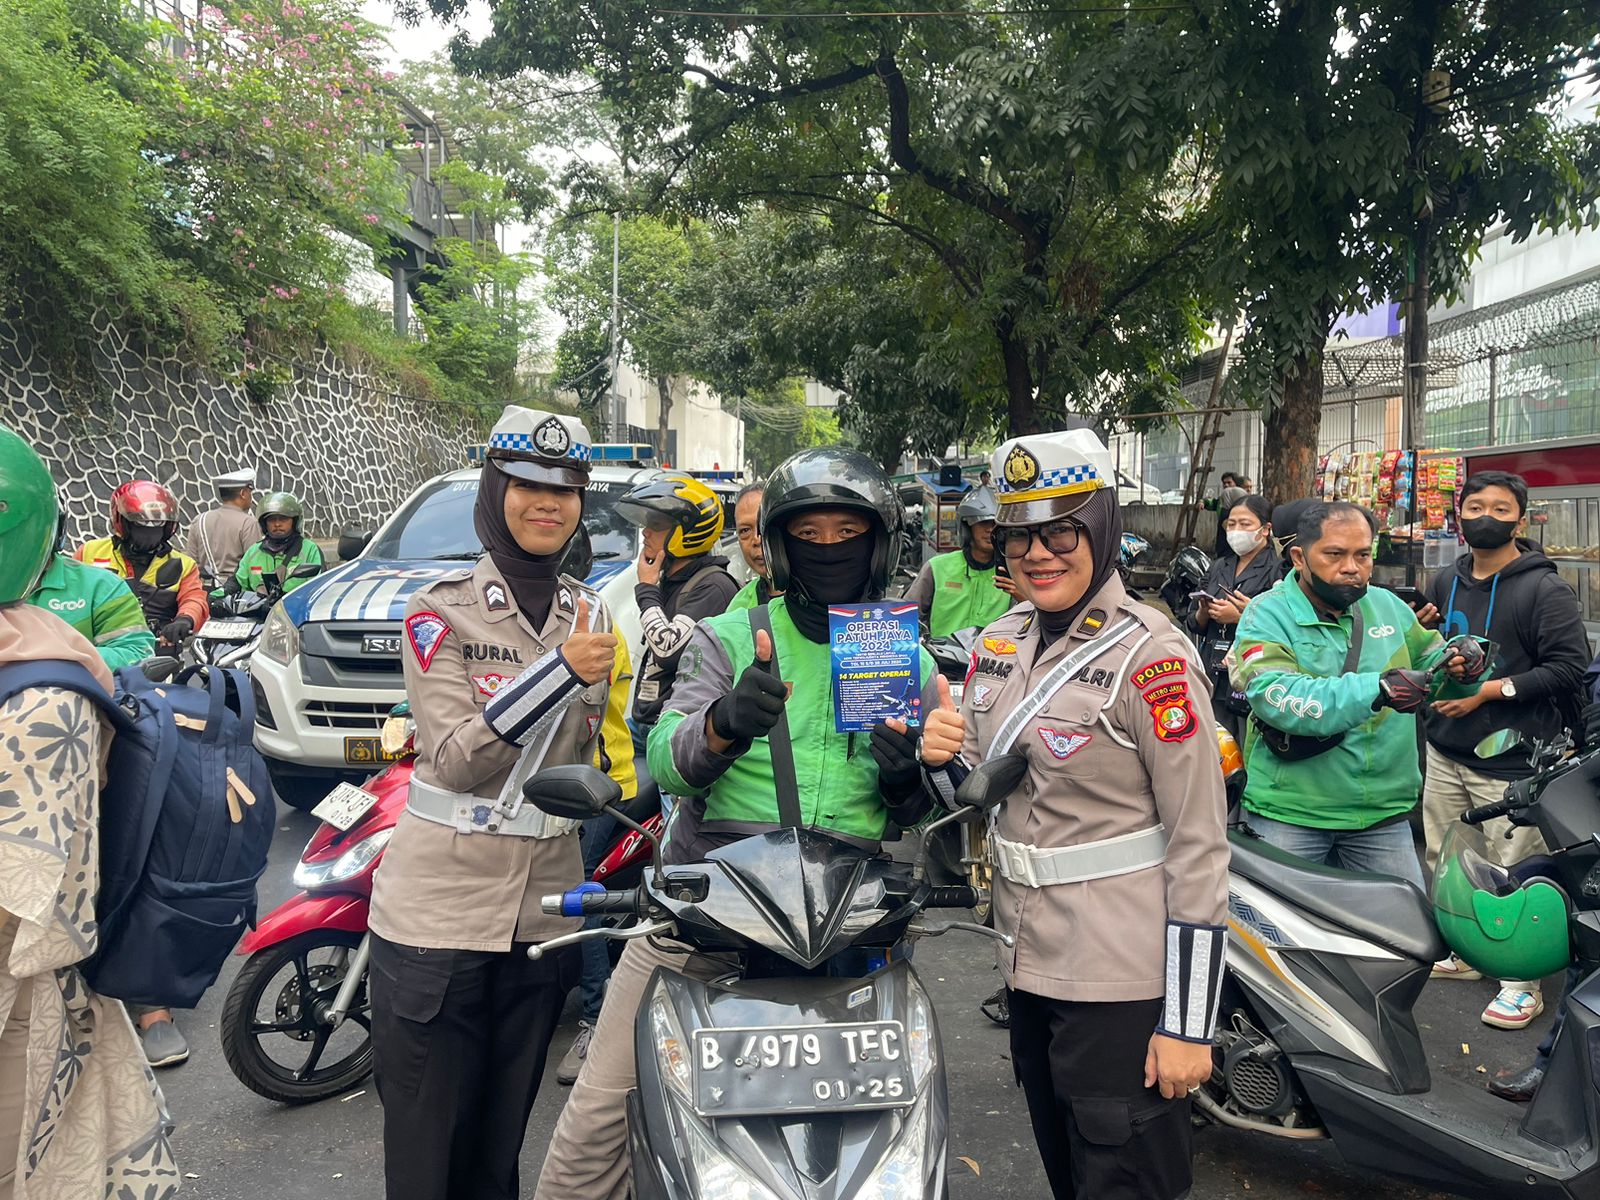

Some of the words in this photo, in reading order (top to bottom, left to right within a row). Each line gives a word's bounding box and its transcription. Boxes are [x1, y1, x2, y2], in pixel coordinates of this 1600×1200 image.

[585, 483, 609, 492] JAYA
[48, 598, 86, 610] Grab
[847, 620, 899, 632] OPERASI
[837, 632, 877, 643] PATUH
[879, 630, 912, 641] JAYA
[365, 639, 400, 652] ISU
[861, 641, 891, 651] 2024
[462, 643, 523, 664] RURAL
[880, 670, 911, 678] OPERASI
[1070, 666, 1114, 688] LRI
[1136, 661, 1182, 685] POLDA
[1148, 688, 1168, 700] METRO
[1169, 684, 1184, 693] JAYA
[1265, 684, 1322, 719] Grab
[702, 1037, 723, 1070] B
[743, 1034, 820, 1067] 4979
